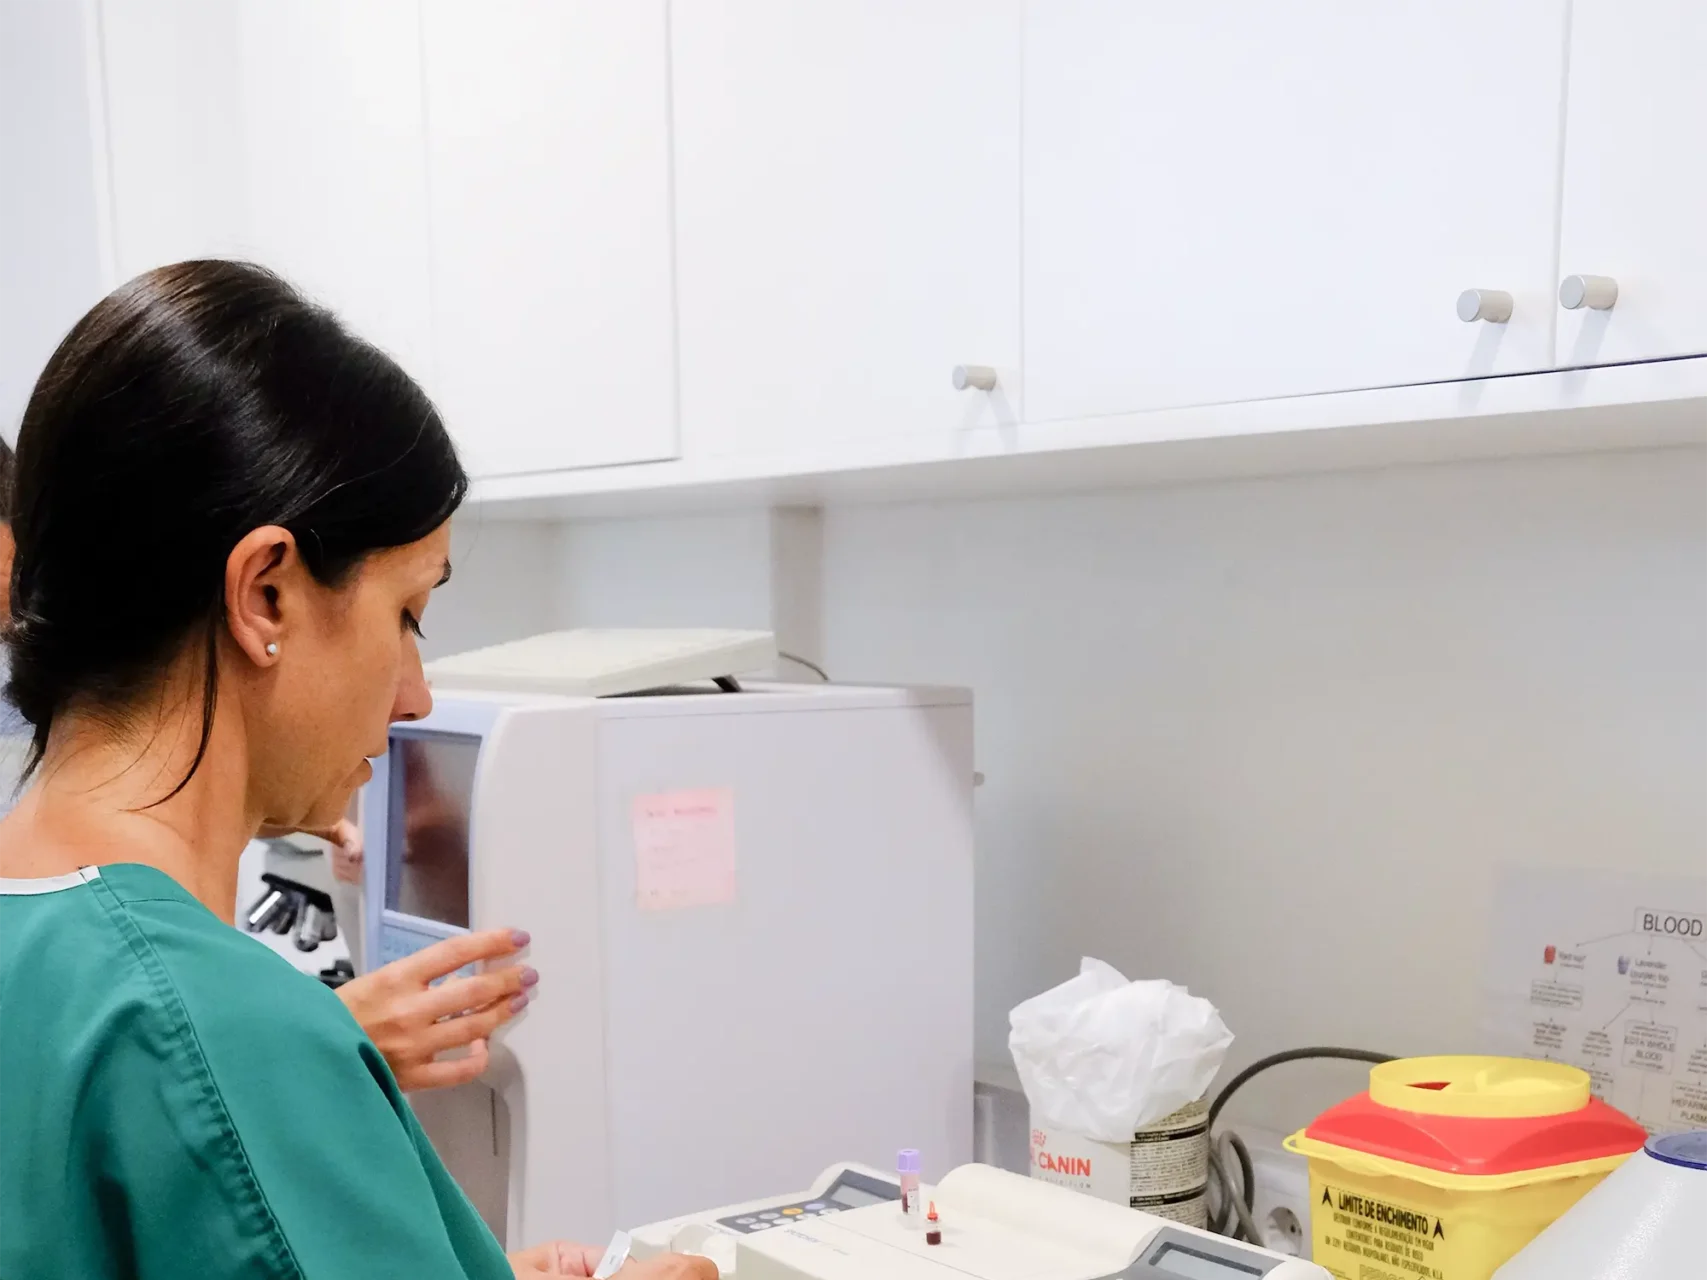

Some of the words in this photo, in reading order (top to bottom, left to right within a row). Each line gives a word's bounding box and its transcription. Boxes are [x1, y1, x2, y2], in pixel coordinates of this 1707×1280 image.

[1643, 913, 1703, 937] BLOOD
[1680, 1110, 1707, 1123] PLASM
[1039, 1152, 1091, 1177] CANIN
[1338, 1191, 1363, 1216] LIMITE
[1364, 1200, 1375, 1219] DE
[1376, 1203, 1429, 1235] ENCHIMENTO
